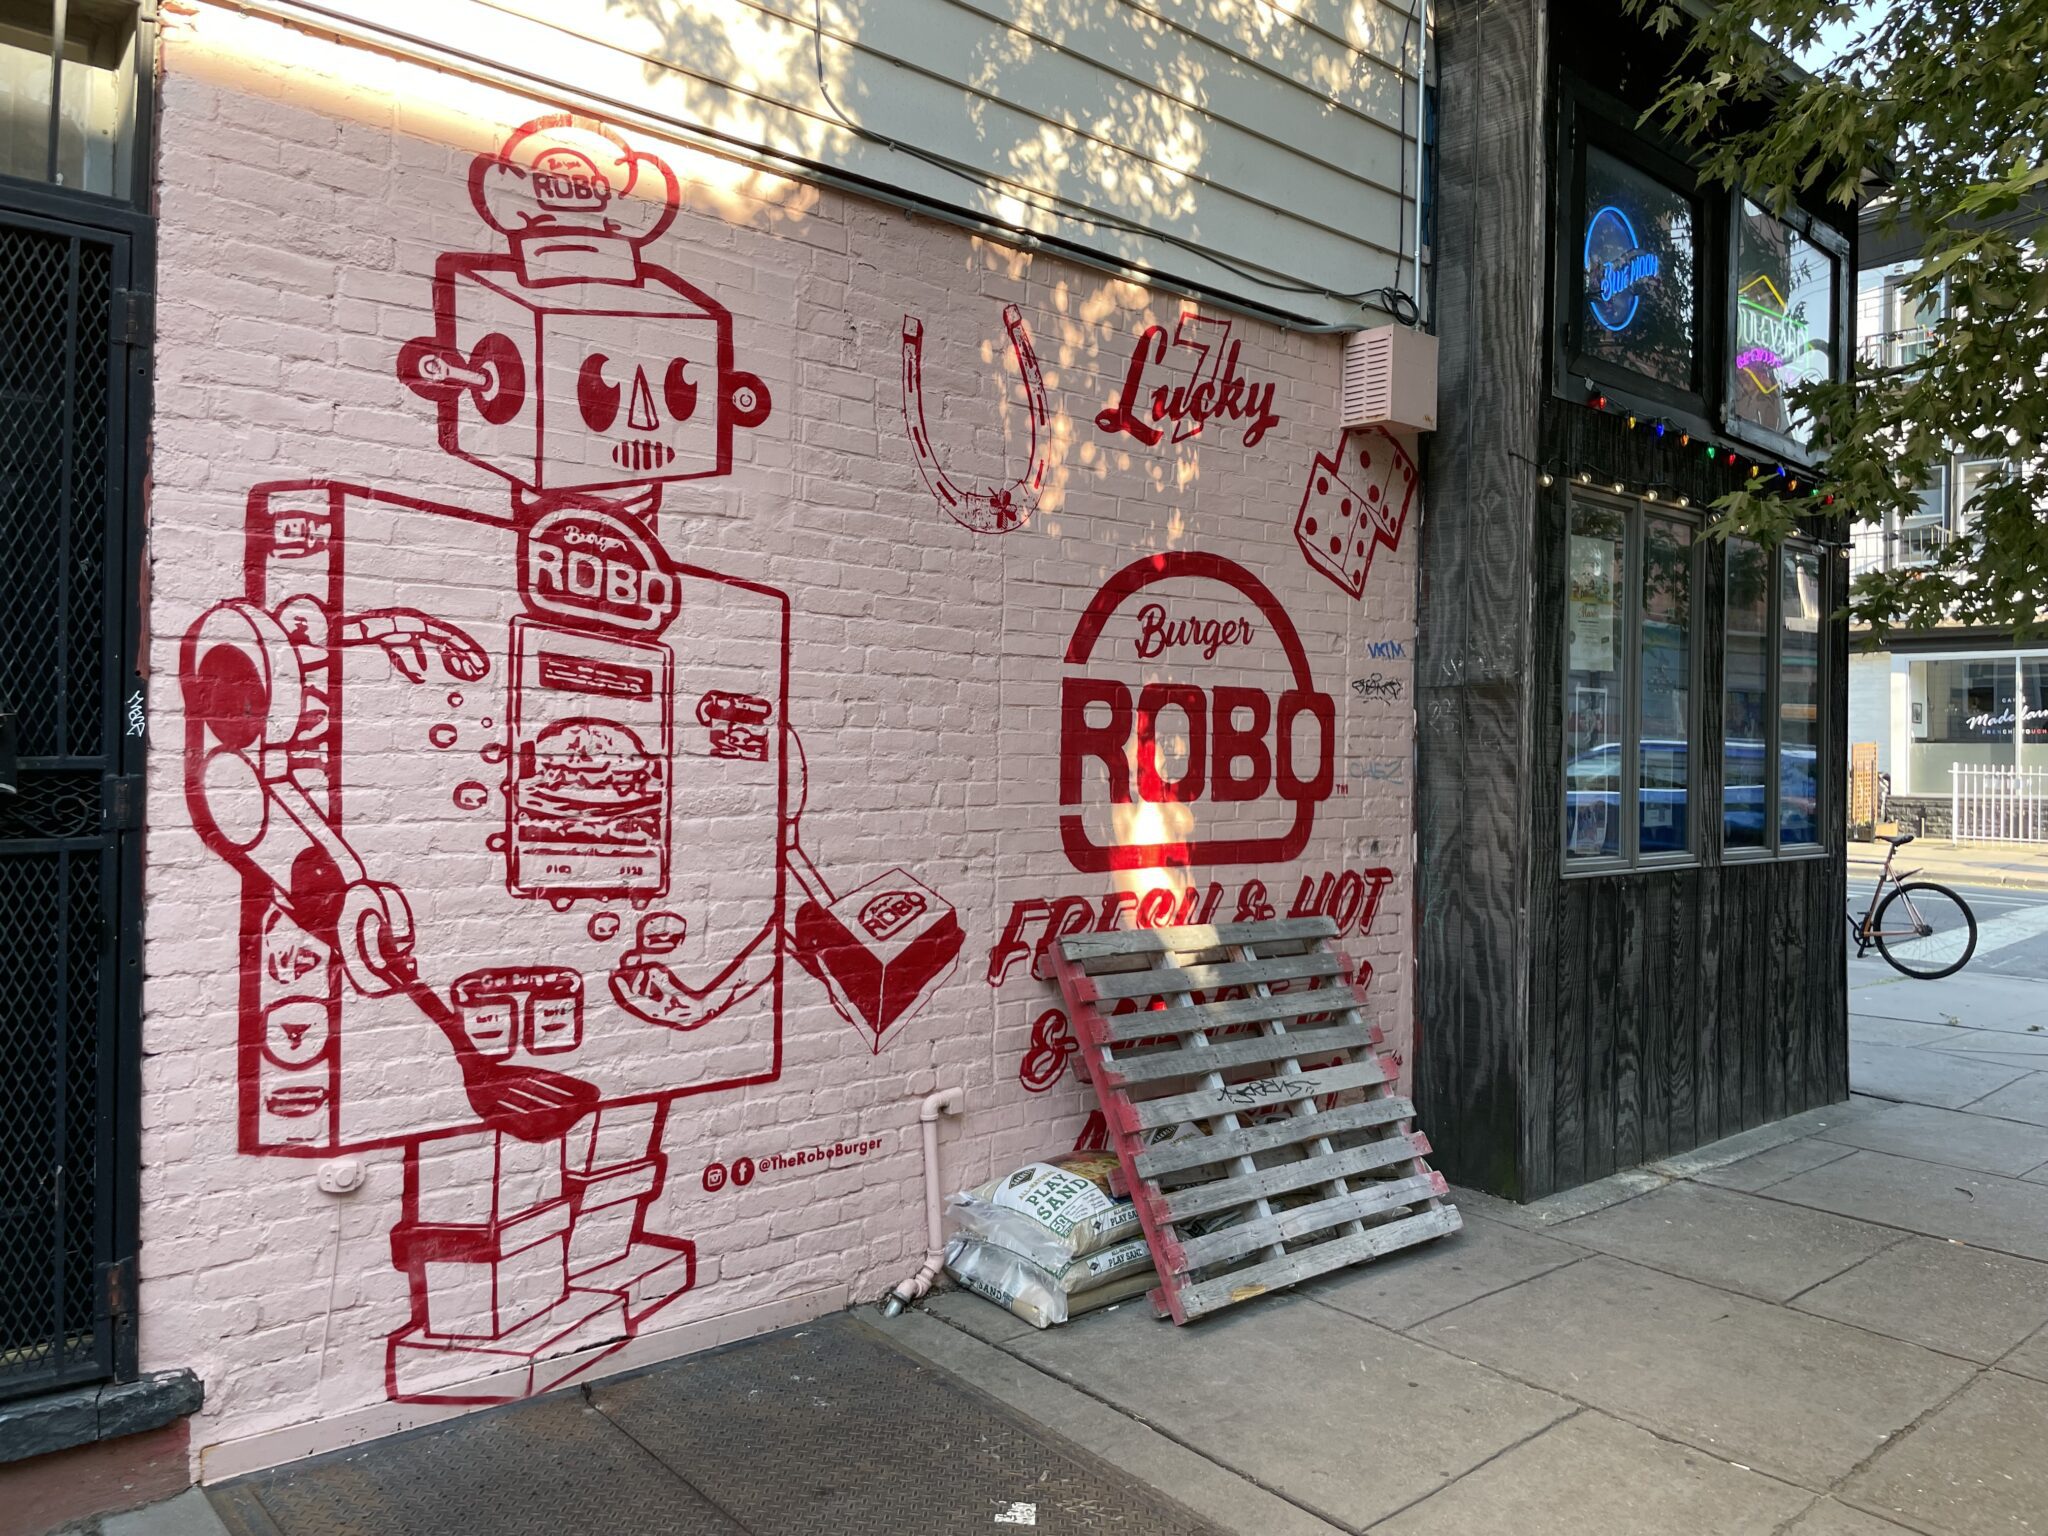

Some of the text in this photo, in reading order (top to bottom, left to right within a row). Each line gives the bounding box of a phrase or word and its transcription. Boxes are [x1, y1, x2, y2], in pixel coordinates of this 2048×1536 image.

[533, 172, 612, 200] ROBO
[1630, 253, 1658, 286] MOON
[1737, 306, 1808, 363] OULEVARD
[1094, 324, 1280, 448] Lucky
[562, 525, 628, 552] Burger
[528, 538, 674, 615] ROBO
[1135, 603, 1255, 660] Burger
[1059, 676, 1336, 806] ROBO
[862, 892, 926, 938] ROBO
[759, 1137, 882, 1173] @TheRoboBurger
[1025, 1173, 1069, 1207] PLAY
[1036, 1178, 1089, 1221] SAND
[1050, 1216, 1068, 1232] 50
[1110, 1209, 1140, 1226] PLAY SA
[1107, 1248, 1143, 1268] PLAY SAND
[976, 1280, 1003, 1301] SAND
